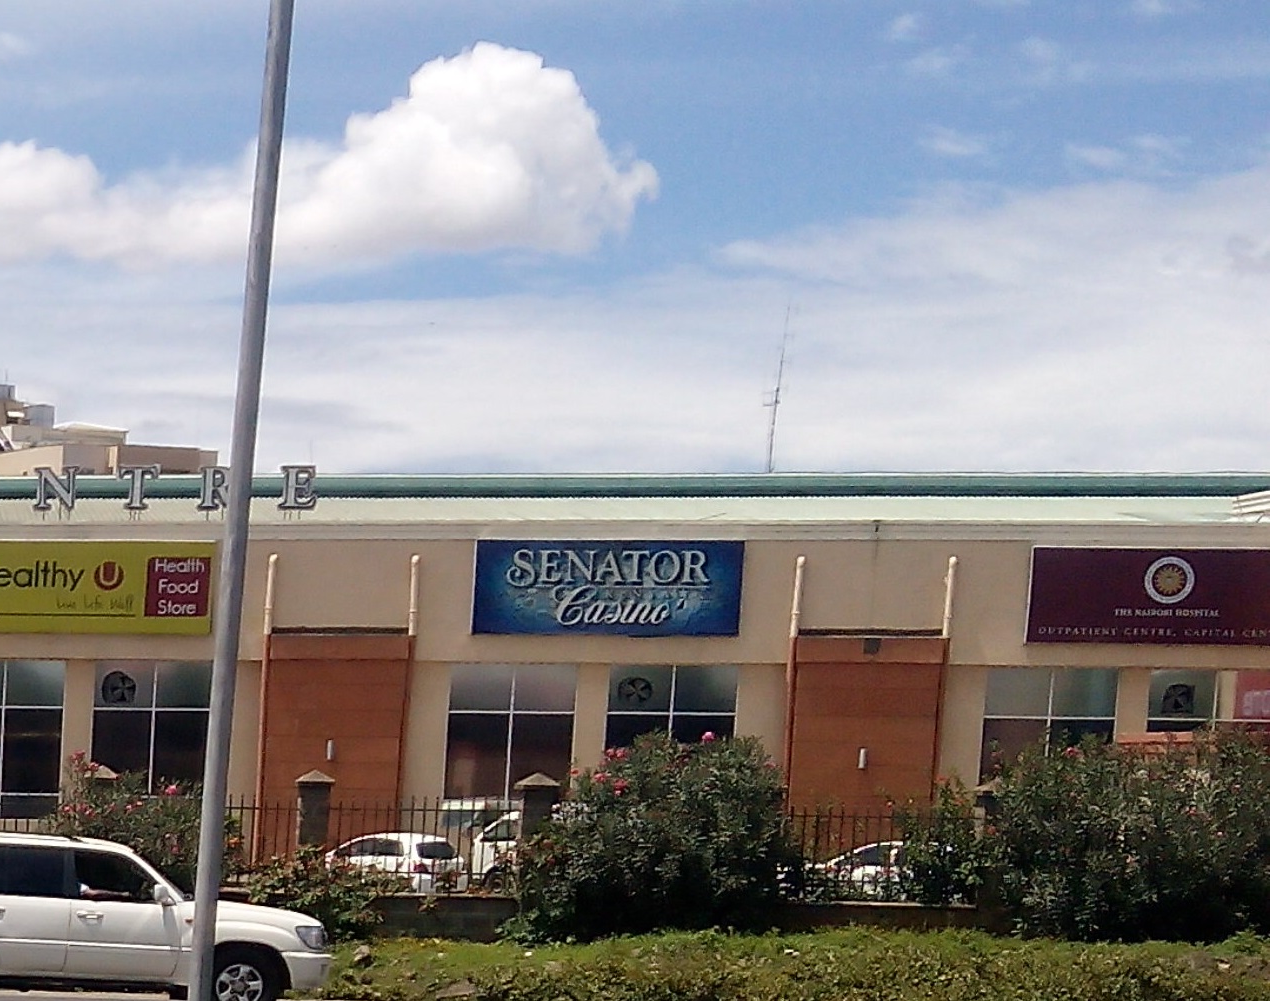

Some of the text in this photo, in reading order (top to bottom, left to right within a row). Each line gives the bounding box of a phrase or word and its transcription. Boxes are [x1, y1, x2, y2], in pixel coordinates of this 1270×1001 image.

[155, 558, 205, 573] Health
[506, 549, 710, 587] SENATOR
[158, 579, 199, 594] Food
[157, 600, 197, 615] Store
[551, 585, 670, 626] Casino
[1114, 608, 1220, 618] THE NAIROBI HOSPITAL
[1038, 627, 1117, 636] OUTPATIENT
[1184, 628, 1235, 638] CAPITAL
